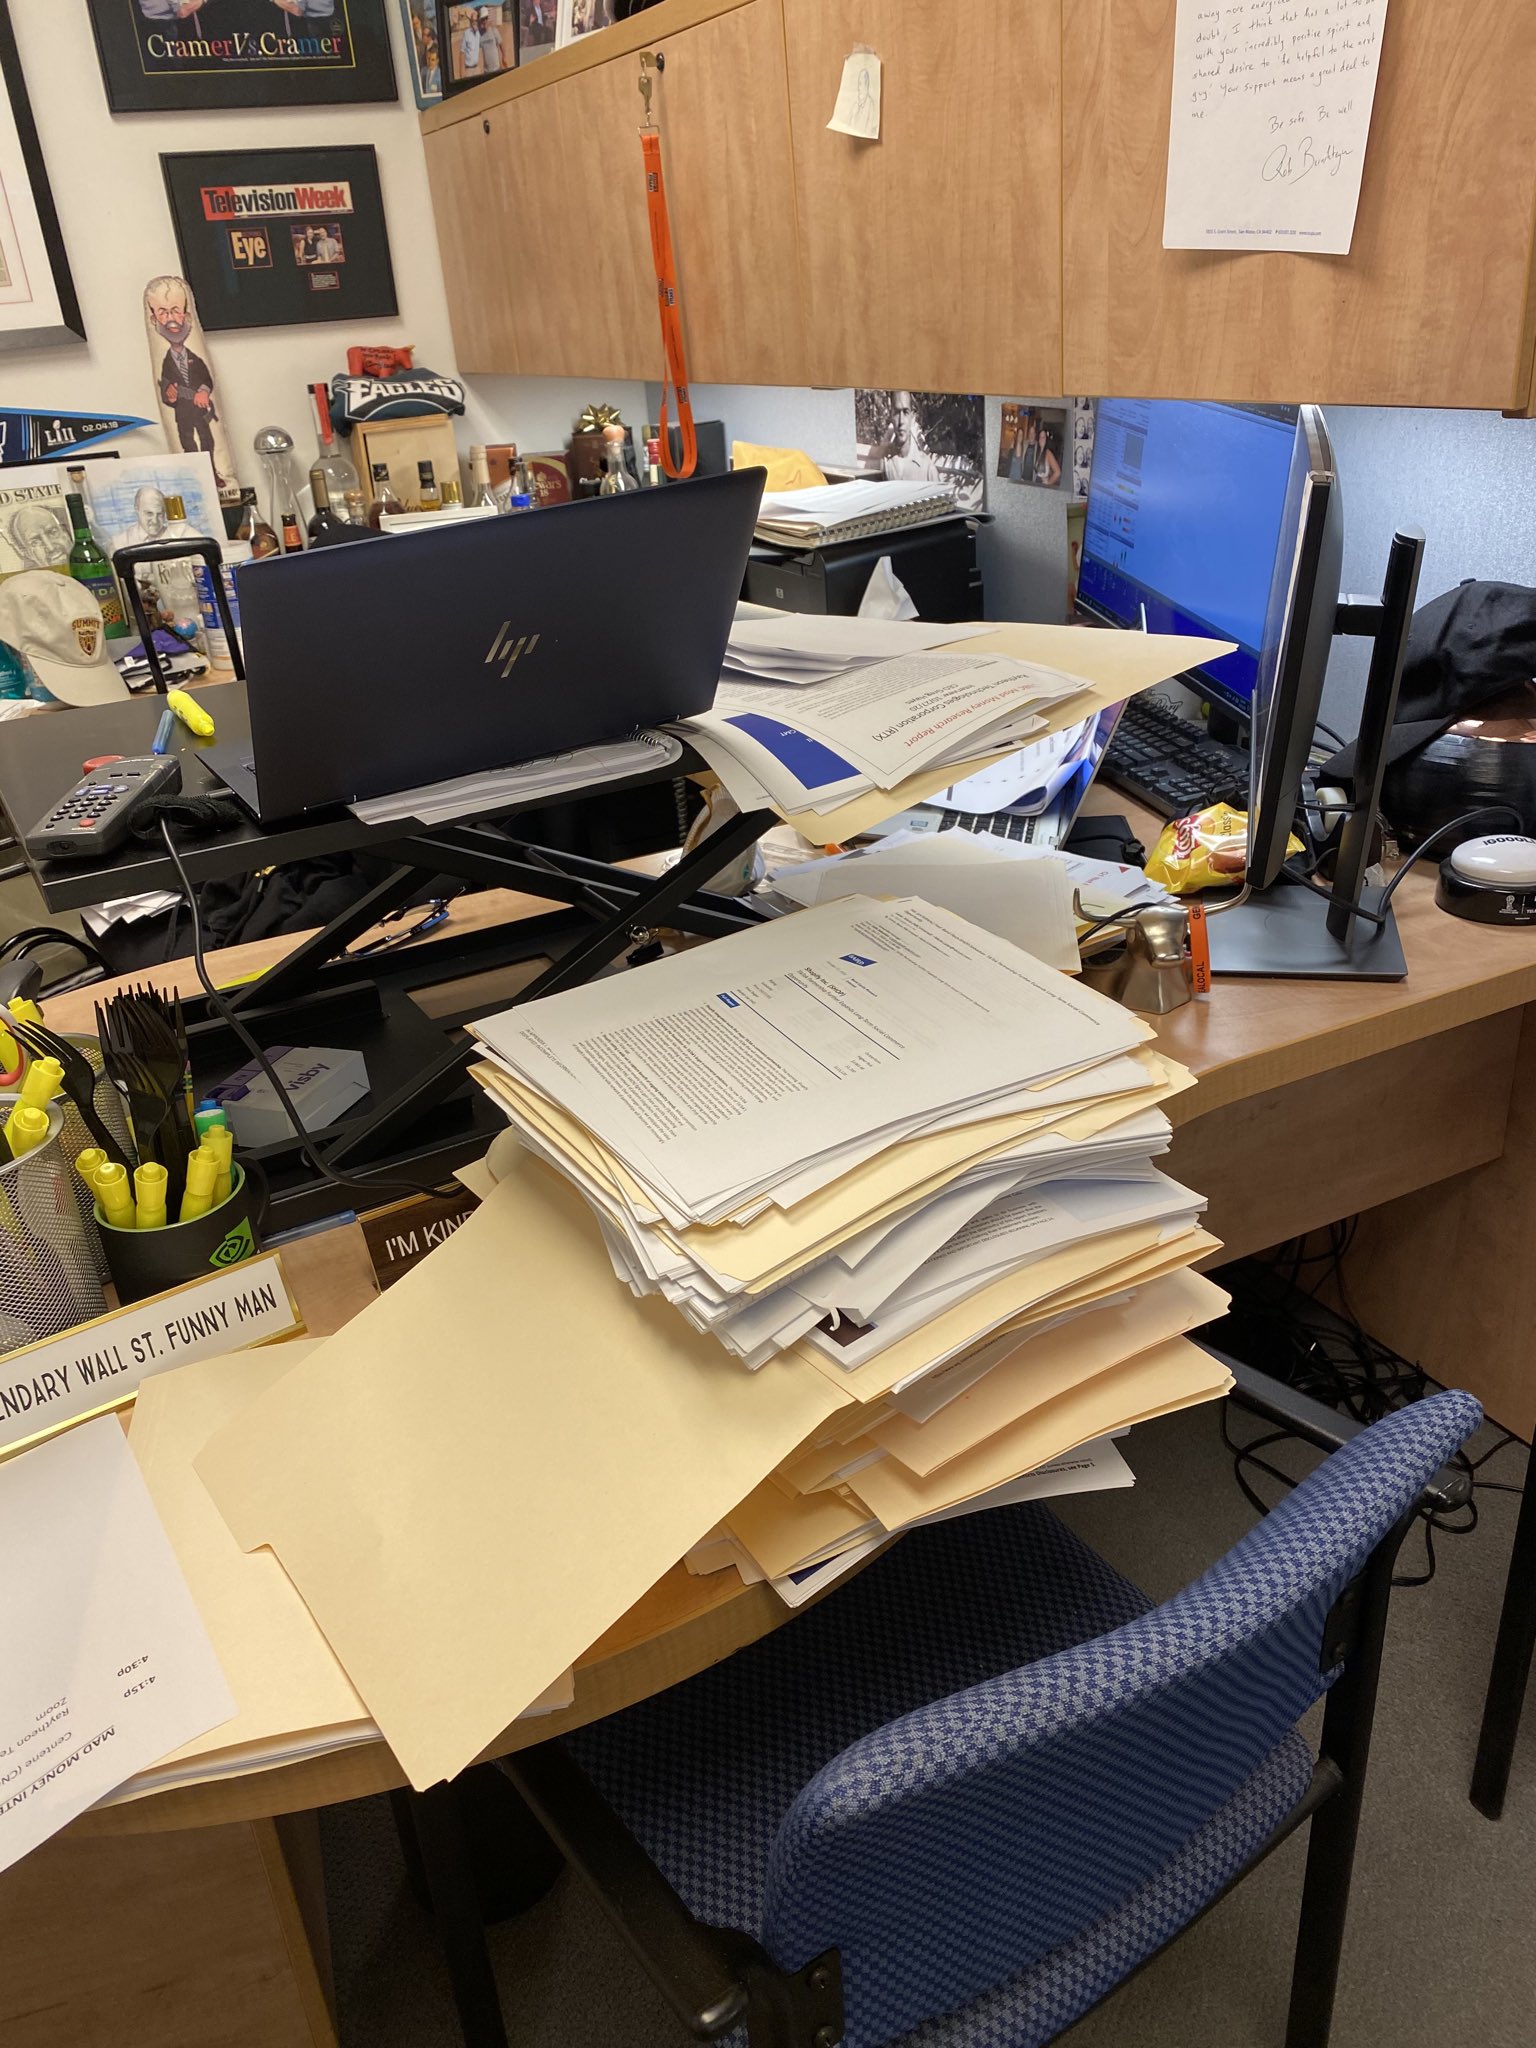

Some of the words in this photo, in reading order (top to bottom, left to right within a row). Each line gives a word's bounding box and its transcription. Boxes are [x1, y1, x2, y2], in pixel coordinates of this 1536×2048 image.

[147, 33, 233, 58] Cramer
[260, 31, 341, 56] Cramer
[231, 231, 267, 265] Eye
[342, 378, 464, 413] EAGLES
[82, 421, 119, 433] 02.04.18
[72, 616, 101, 631] SUMMIT
[872, 721, 899, 742] (RTX)
[934, 706, 972, 731] Research
[904, 727, 935, 748] Report
[285, 1062, 330, 1091] visby
[385, 1230, 420, 1261] I'M
[0, 1365, 71, 1421] NDARY
[75, 1345, 128, 1385] WALL
[130, 1331, 164, 1363] ST.
[165, 1301, 229, 1350] FUNNY
[234, 1283, 278, 1322] MAN
[117, 1655, 149, 1677] 4:30p
[123, 1675, 156, 1698] 4:15p
[35, 1697, 67, 1721] Zoom
[17, 1708, 69, 1747] Raytheon
[83, 1727, 115, 1754] MAD
[25, 1732, 72, 1768] Centene
[30, 1753, 80, 1795] MONEY
